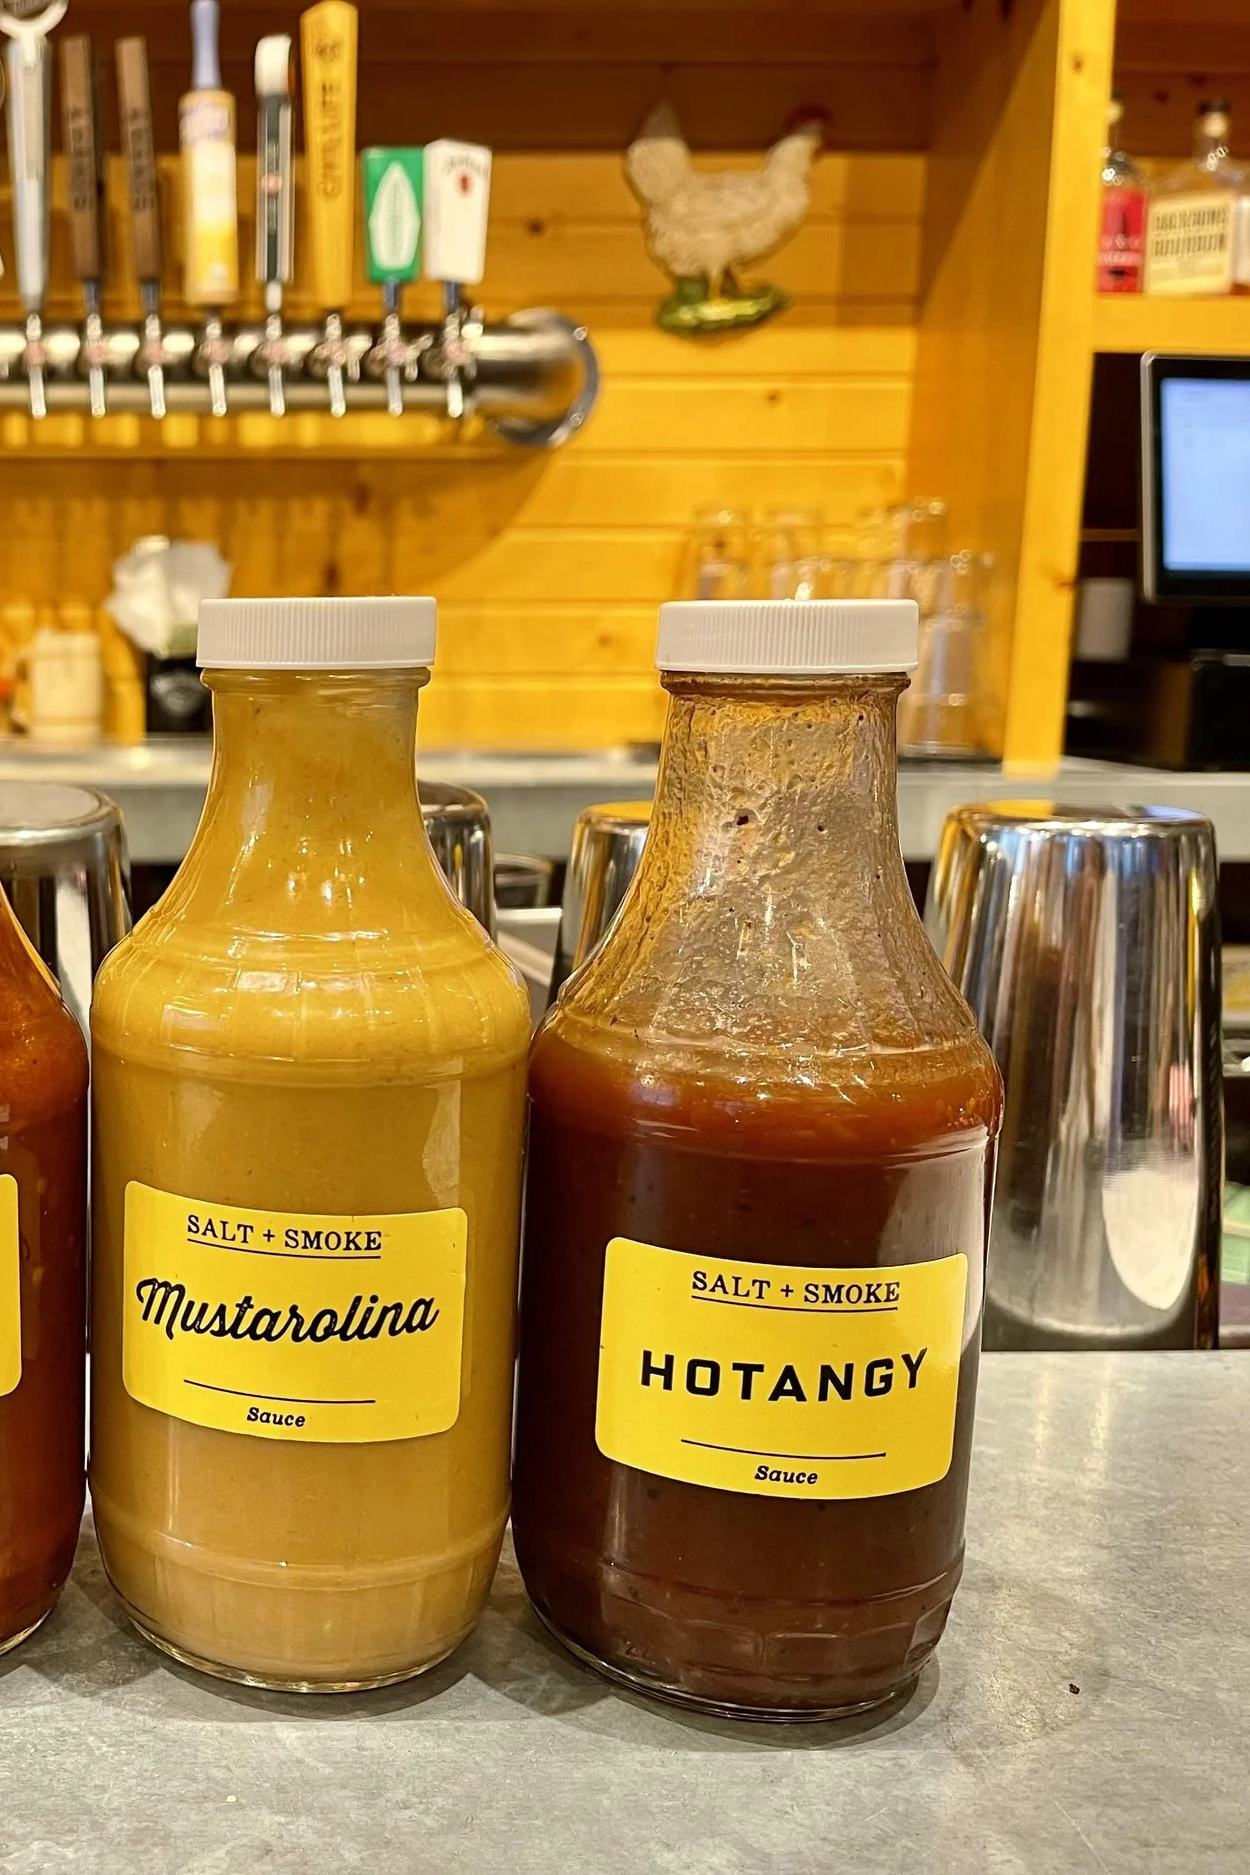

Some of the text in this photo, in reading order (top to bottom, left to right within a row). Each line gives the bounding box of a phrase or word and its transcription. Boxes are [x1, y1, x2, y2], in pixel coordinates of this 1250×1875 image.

[187, 1214, 254, 1245] SALT
[284, 1228, 382, 1251] SMOKE
[691, 1270, 771, 1300] SALT
[803, 1281, 900, 1305] SMOKE
[135, 1277, 440, 1343] Mustarolina
[640, 1347, 928, 1402] HOTANGY
[246, 1406, 306, 1428] Sauce
[754, 1465, 818, 1485] Sauce
